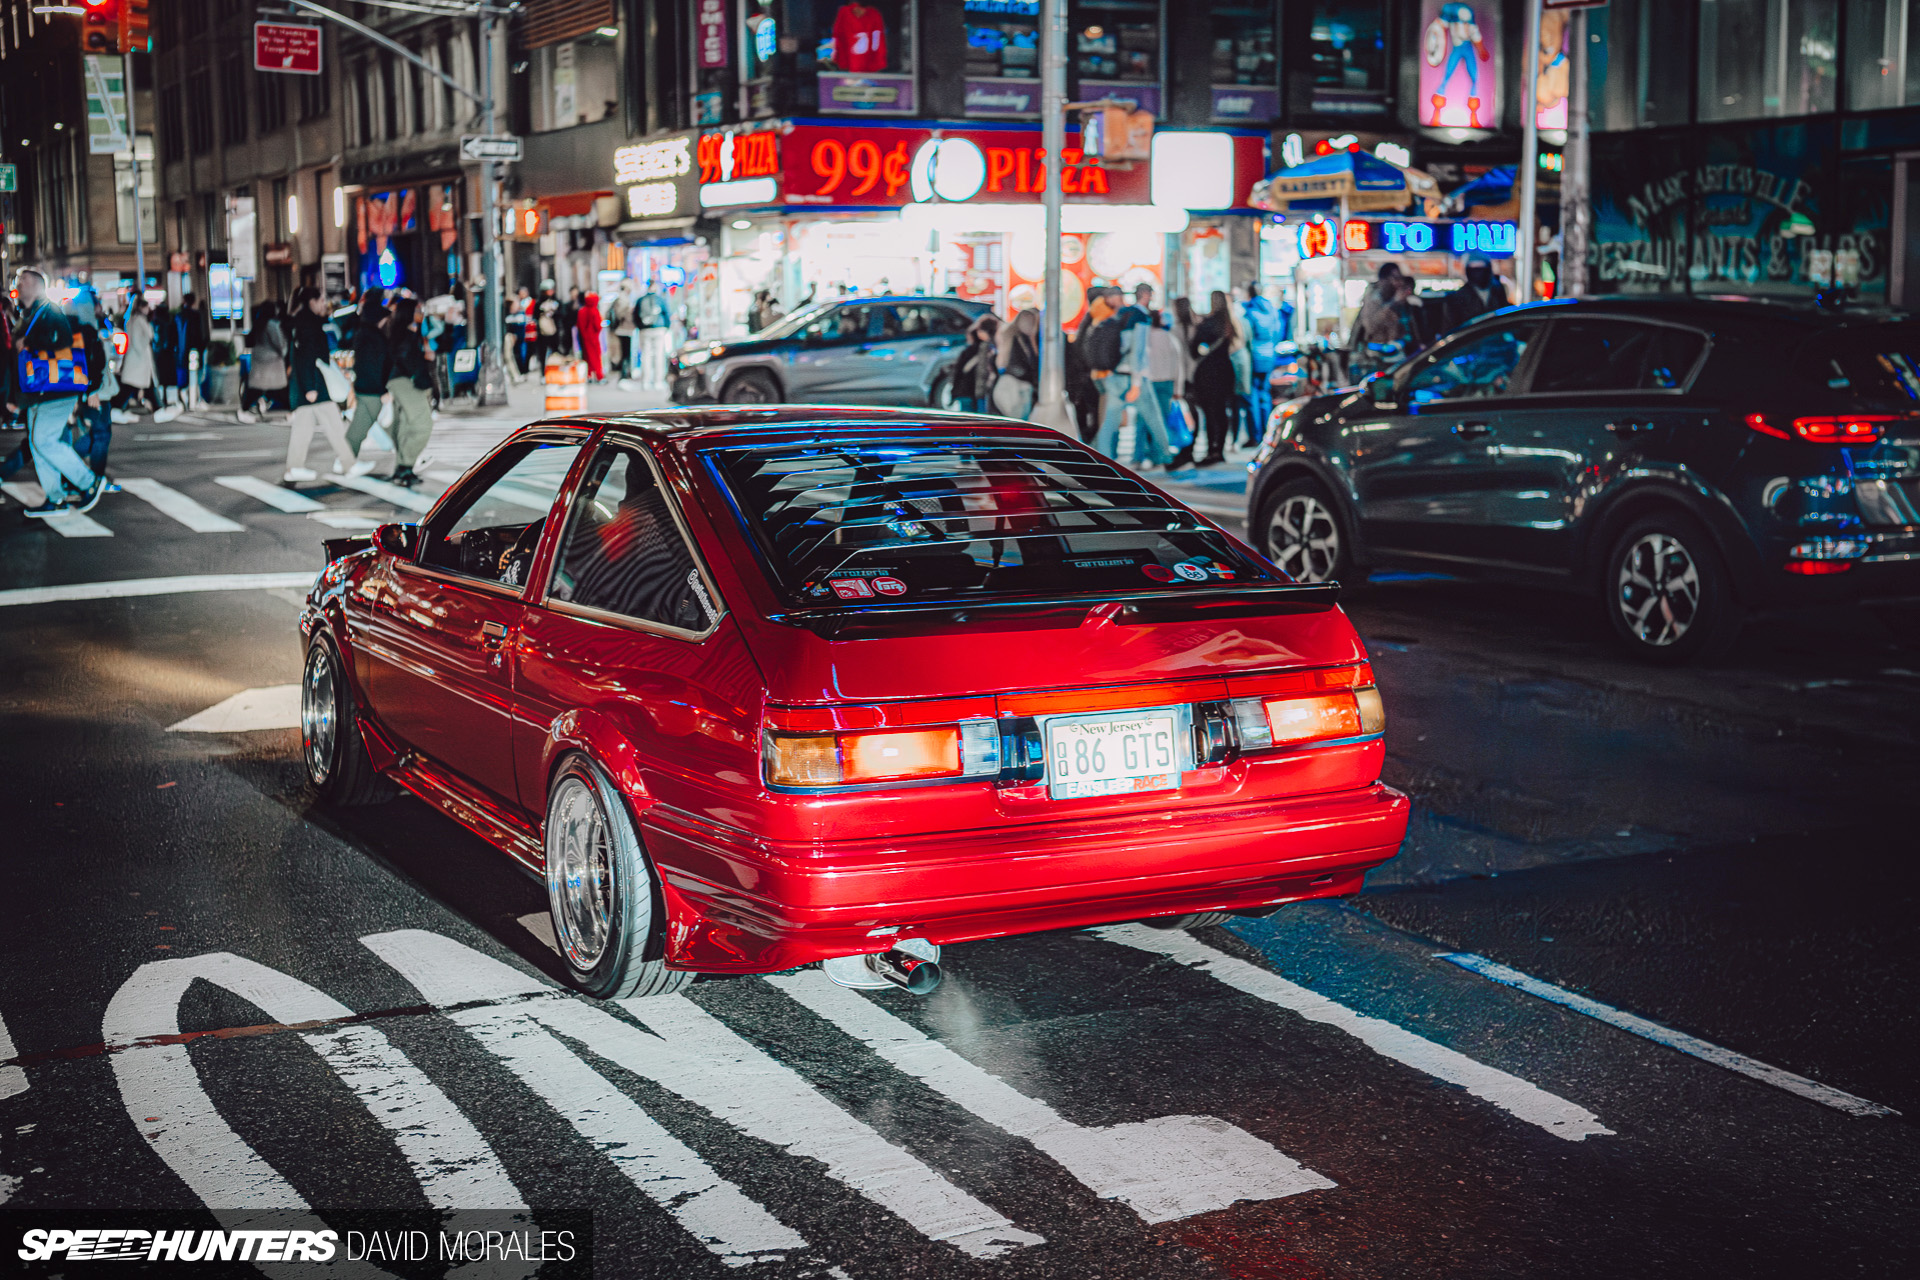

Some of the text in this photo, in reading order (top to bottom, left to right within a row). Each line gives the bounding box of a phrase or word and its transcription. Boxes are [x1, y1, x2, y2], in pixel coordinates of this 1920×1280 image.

[986, 148, 1110, 193] PIZZA
[1800, 234, 1877, 280] BS
[1079, 721, 1143, 735] New Jersey
[1074, 737, 1106, 775] 86
[1122, 731, 1171, 770] GTS
